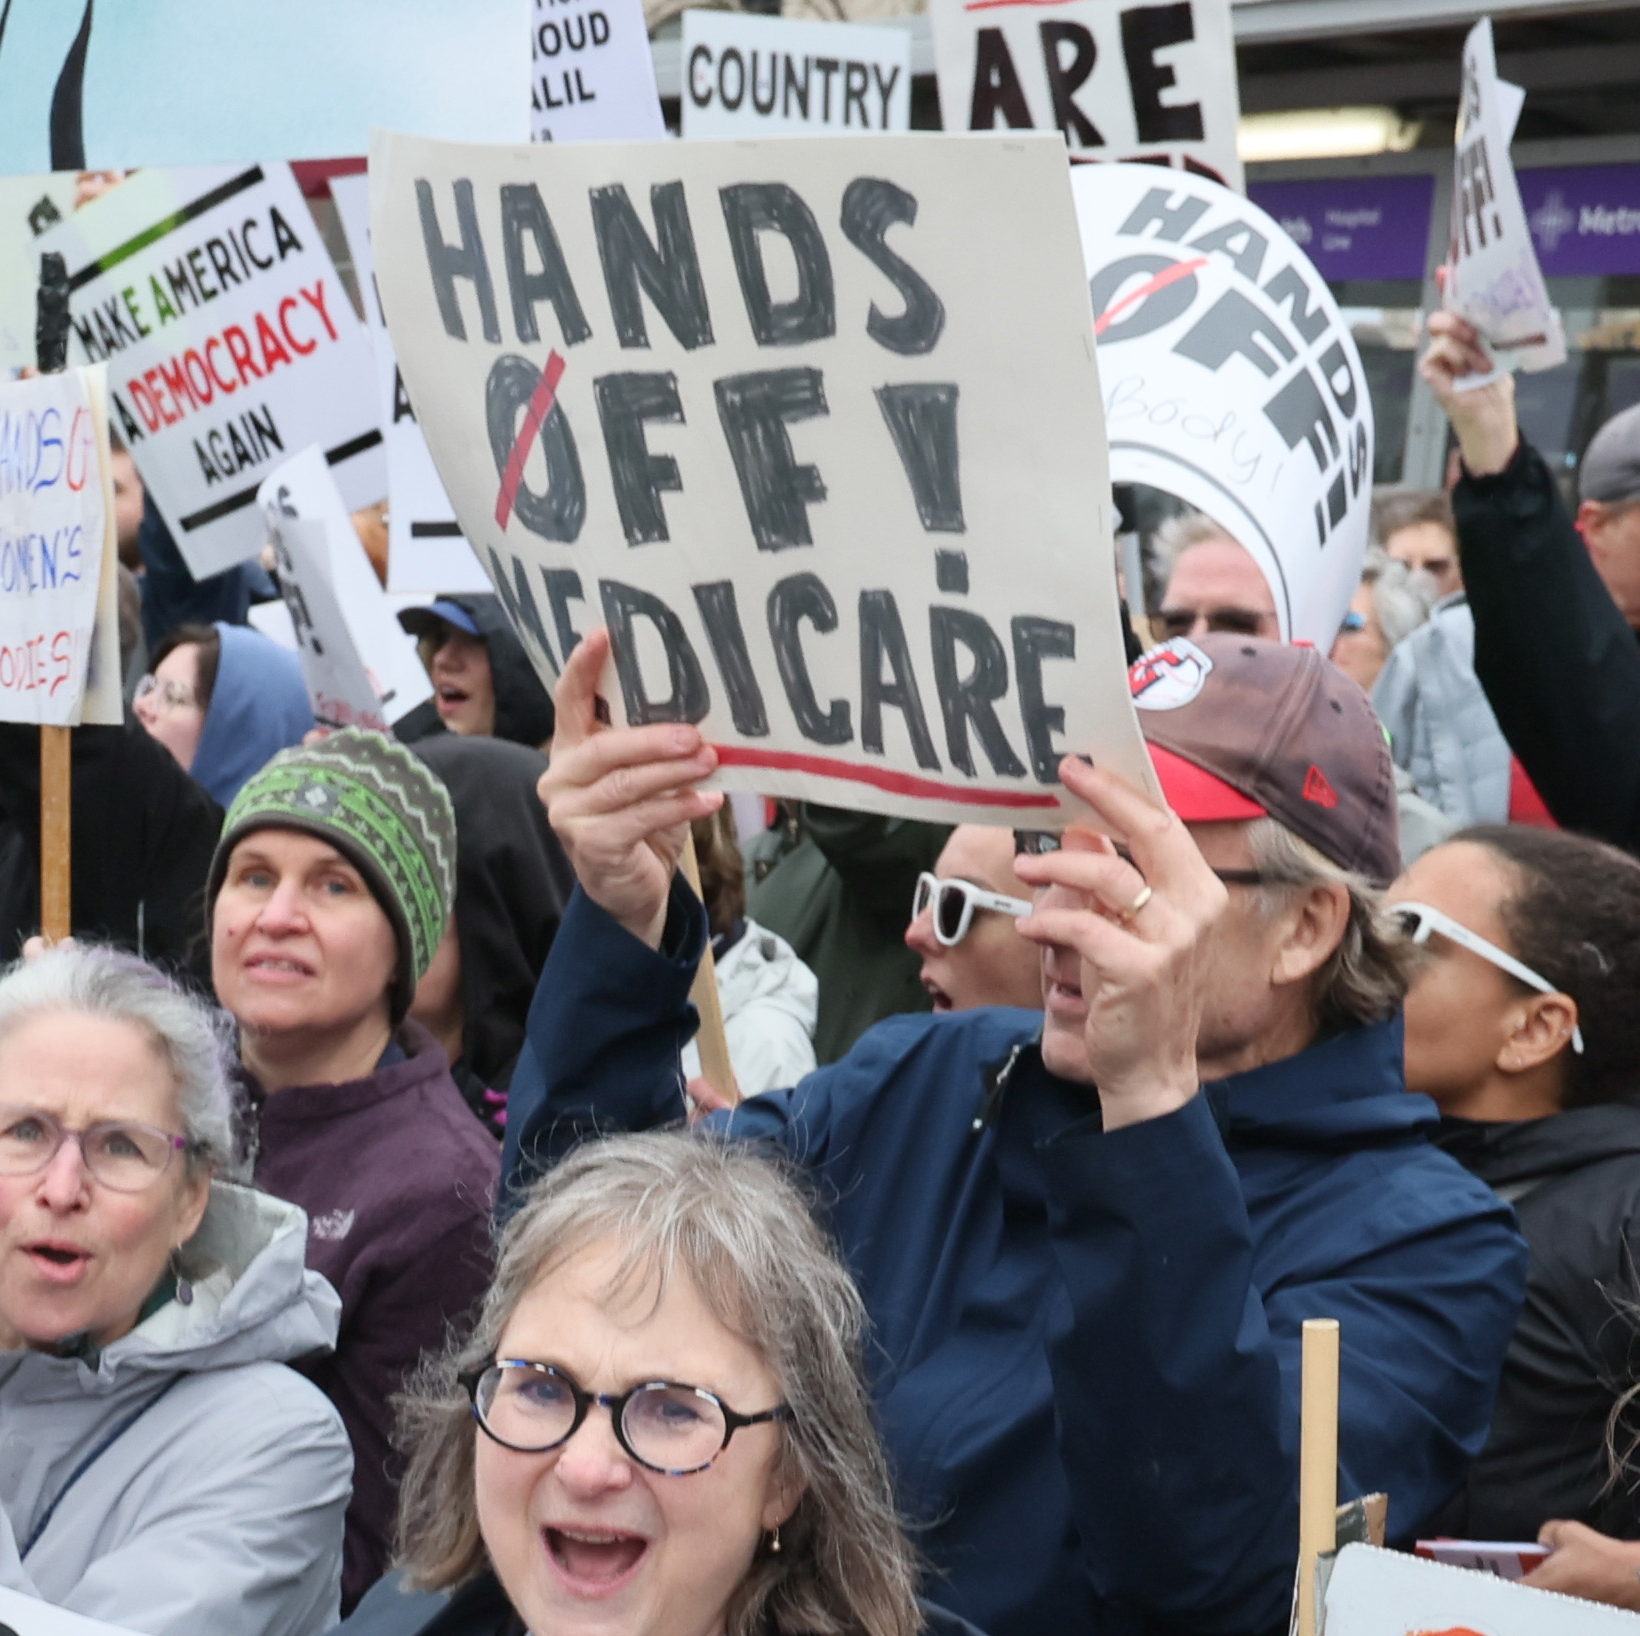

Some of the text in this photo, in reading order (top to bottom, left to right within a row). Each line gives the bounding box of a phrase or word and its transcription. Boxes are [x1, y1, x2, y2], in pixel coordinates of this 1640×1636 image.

[687, 42, 901, 130] COUNTRY
[970, 3, 1206, 148] ARE
[71, 205, 305, 363] MAKE AMERICA
[414, 175, 947, 357] HANDS
[1117, 186, 1368, 501] HANDS
[110, 387, 146, 444] A
[127, 279, 344, 434] DEMOCRACY
[1091, 253, 1348, 550] OFF!
[192, 403, 287, 488] AGAIN
[484, 350, 970, 597] OFF!
[486, 545, 1094, 787] MEDICARE
